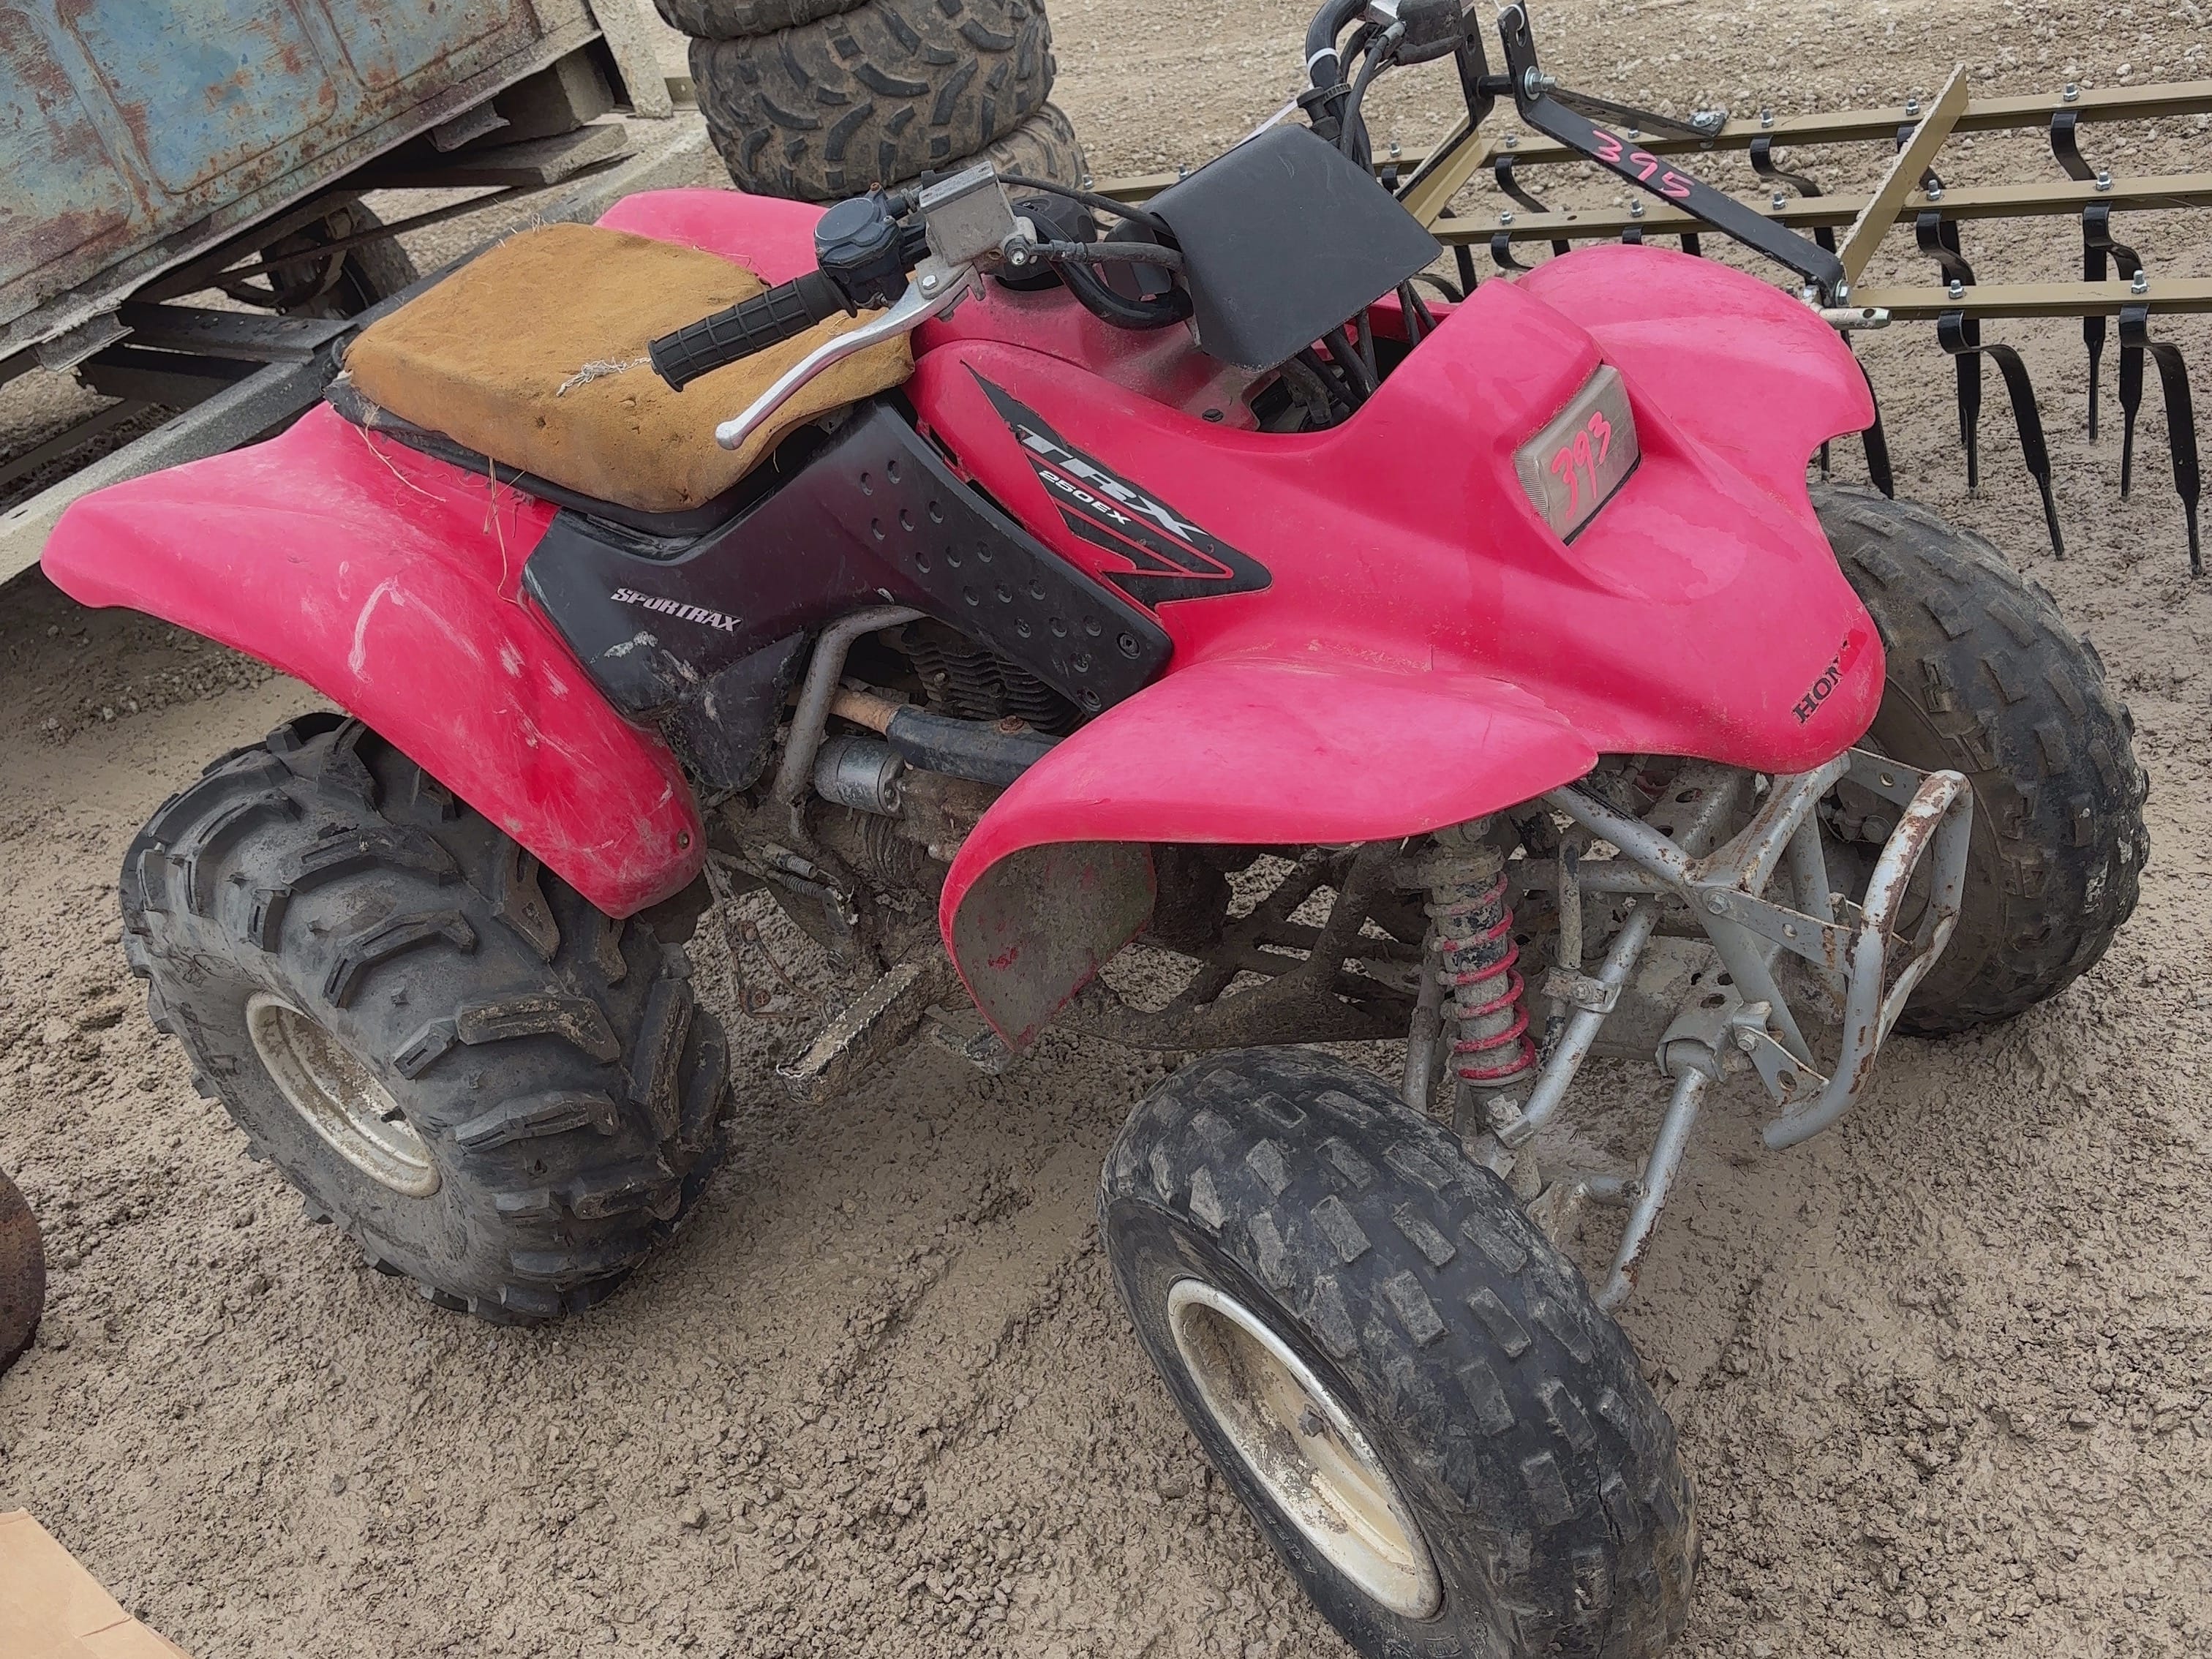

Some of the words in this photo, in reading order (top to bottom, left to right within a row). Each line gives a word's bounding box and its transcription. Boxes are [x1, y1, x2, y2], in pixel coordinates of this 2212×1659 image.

[1591, 129, 1696, 198] 395
[1017, 424, 1209, 543] TRX
[1551, 411, 1611, 521] 393
[610, 587, 742, 633] SPORTRAX
